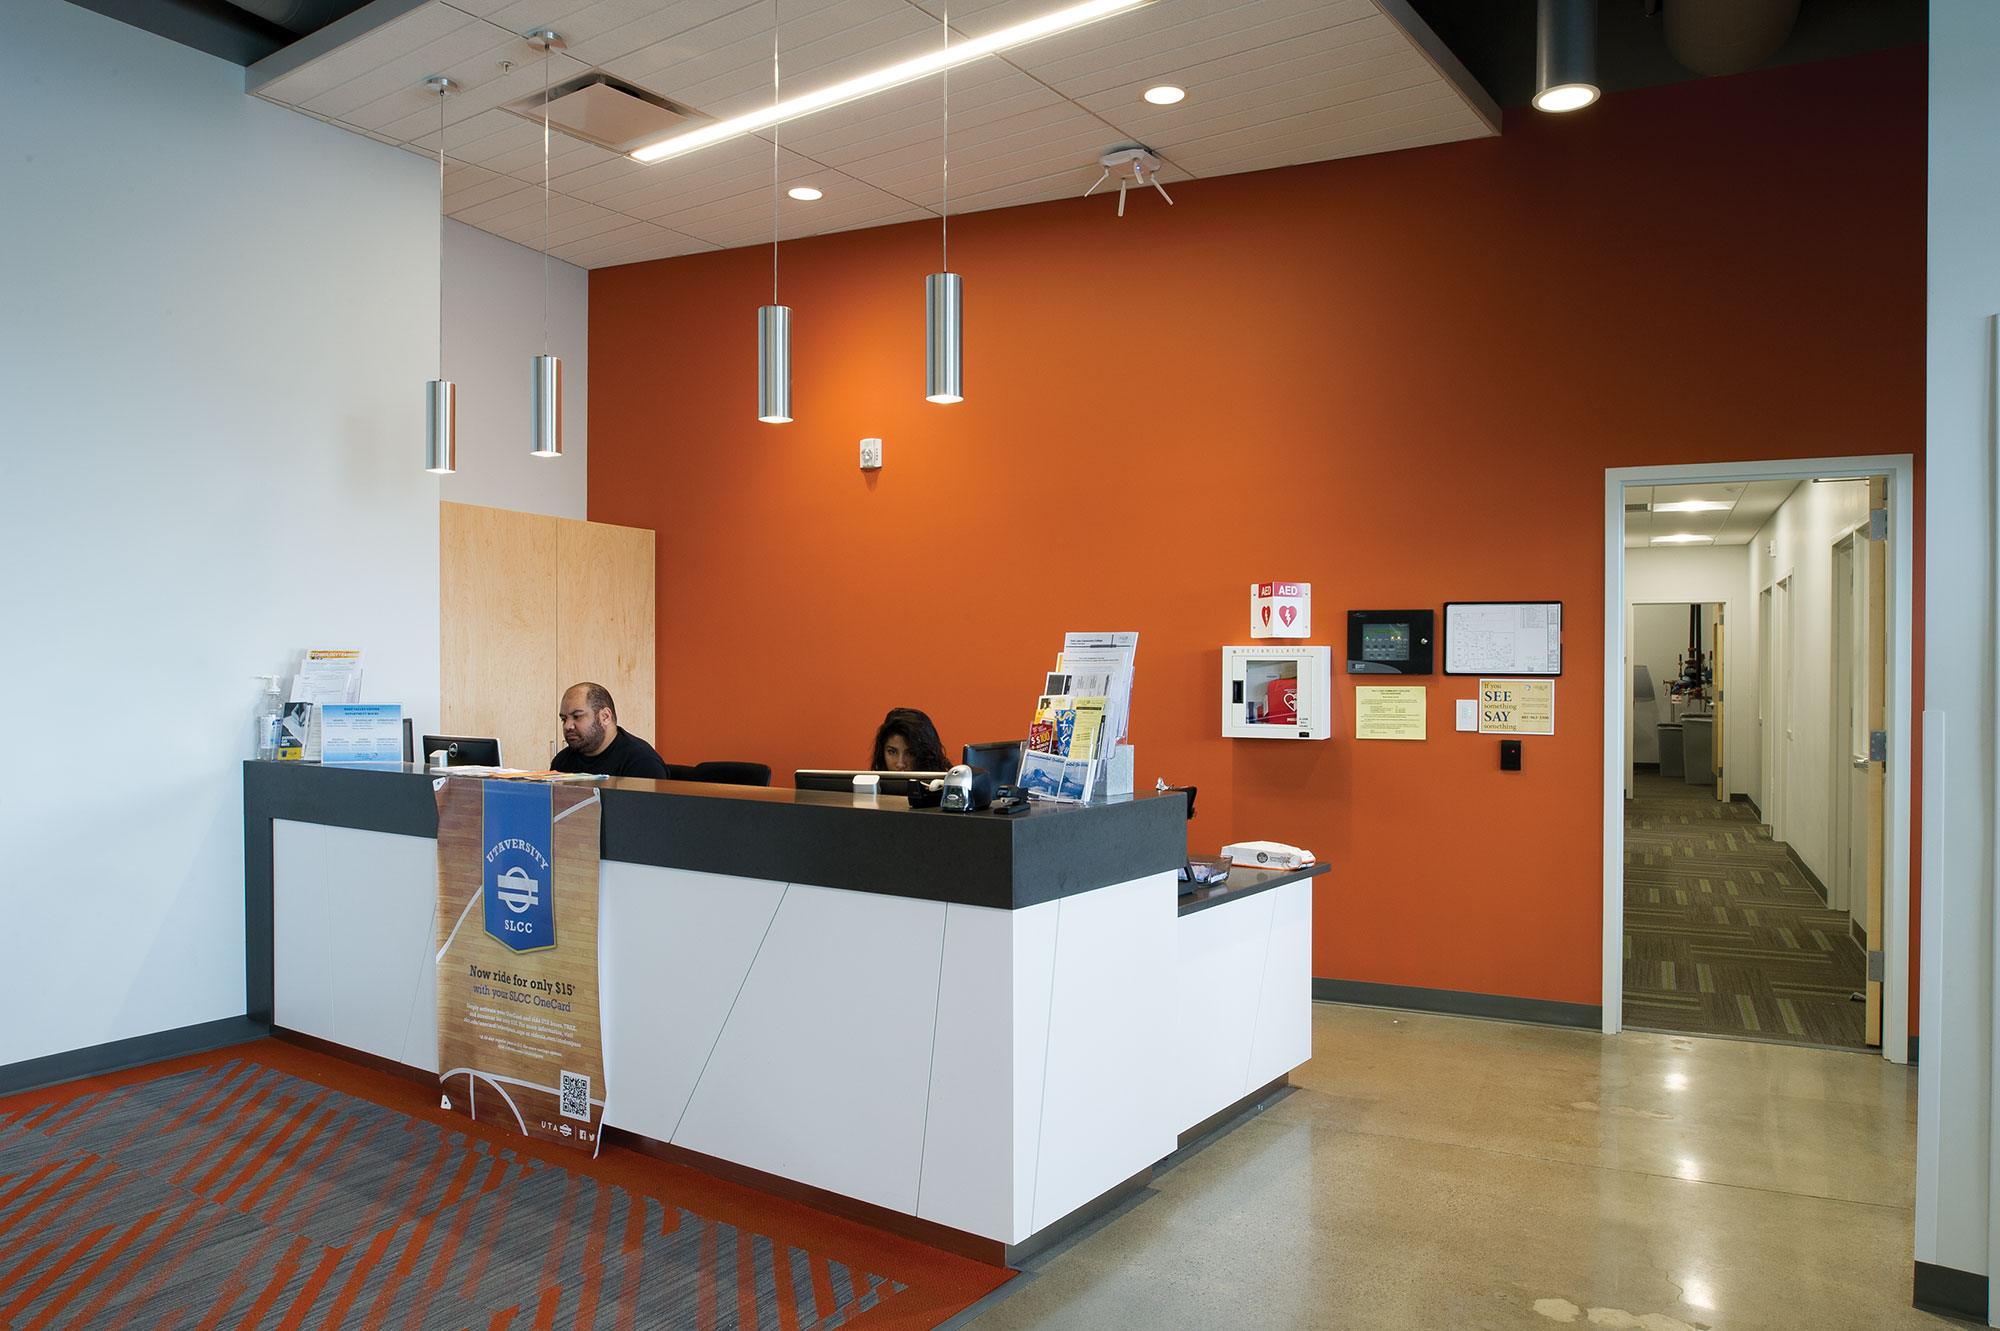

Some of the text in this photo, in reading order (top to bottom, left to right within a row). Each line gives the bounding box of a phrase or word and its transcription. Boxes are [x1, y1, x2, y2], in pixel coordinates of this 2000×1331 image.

[1261, 585, 1272, 596] AED
[1278, 585, 1298, 596] AED
[1484, 690, 1513, 702] SEE
[1484, 702, 1518, 711] something
[1484, 710, 1511, 722] SAY
[1484, 723, 1518, 732] something
[486, 838, 549, 870] UTAVERSITY
[504, 919, 533, 934] SLCC
[469, 965, 491, 980] Now
[493, 970, 511, 984] ride
[513, 974, 528, 988] for
[530, 979, 553, 995] only
[473, 984, 571, 1012] with your SLCC OneCard
[541, 1120, 558, 1132] UTA
